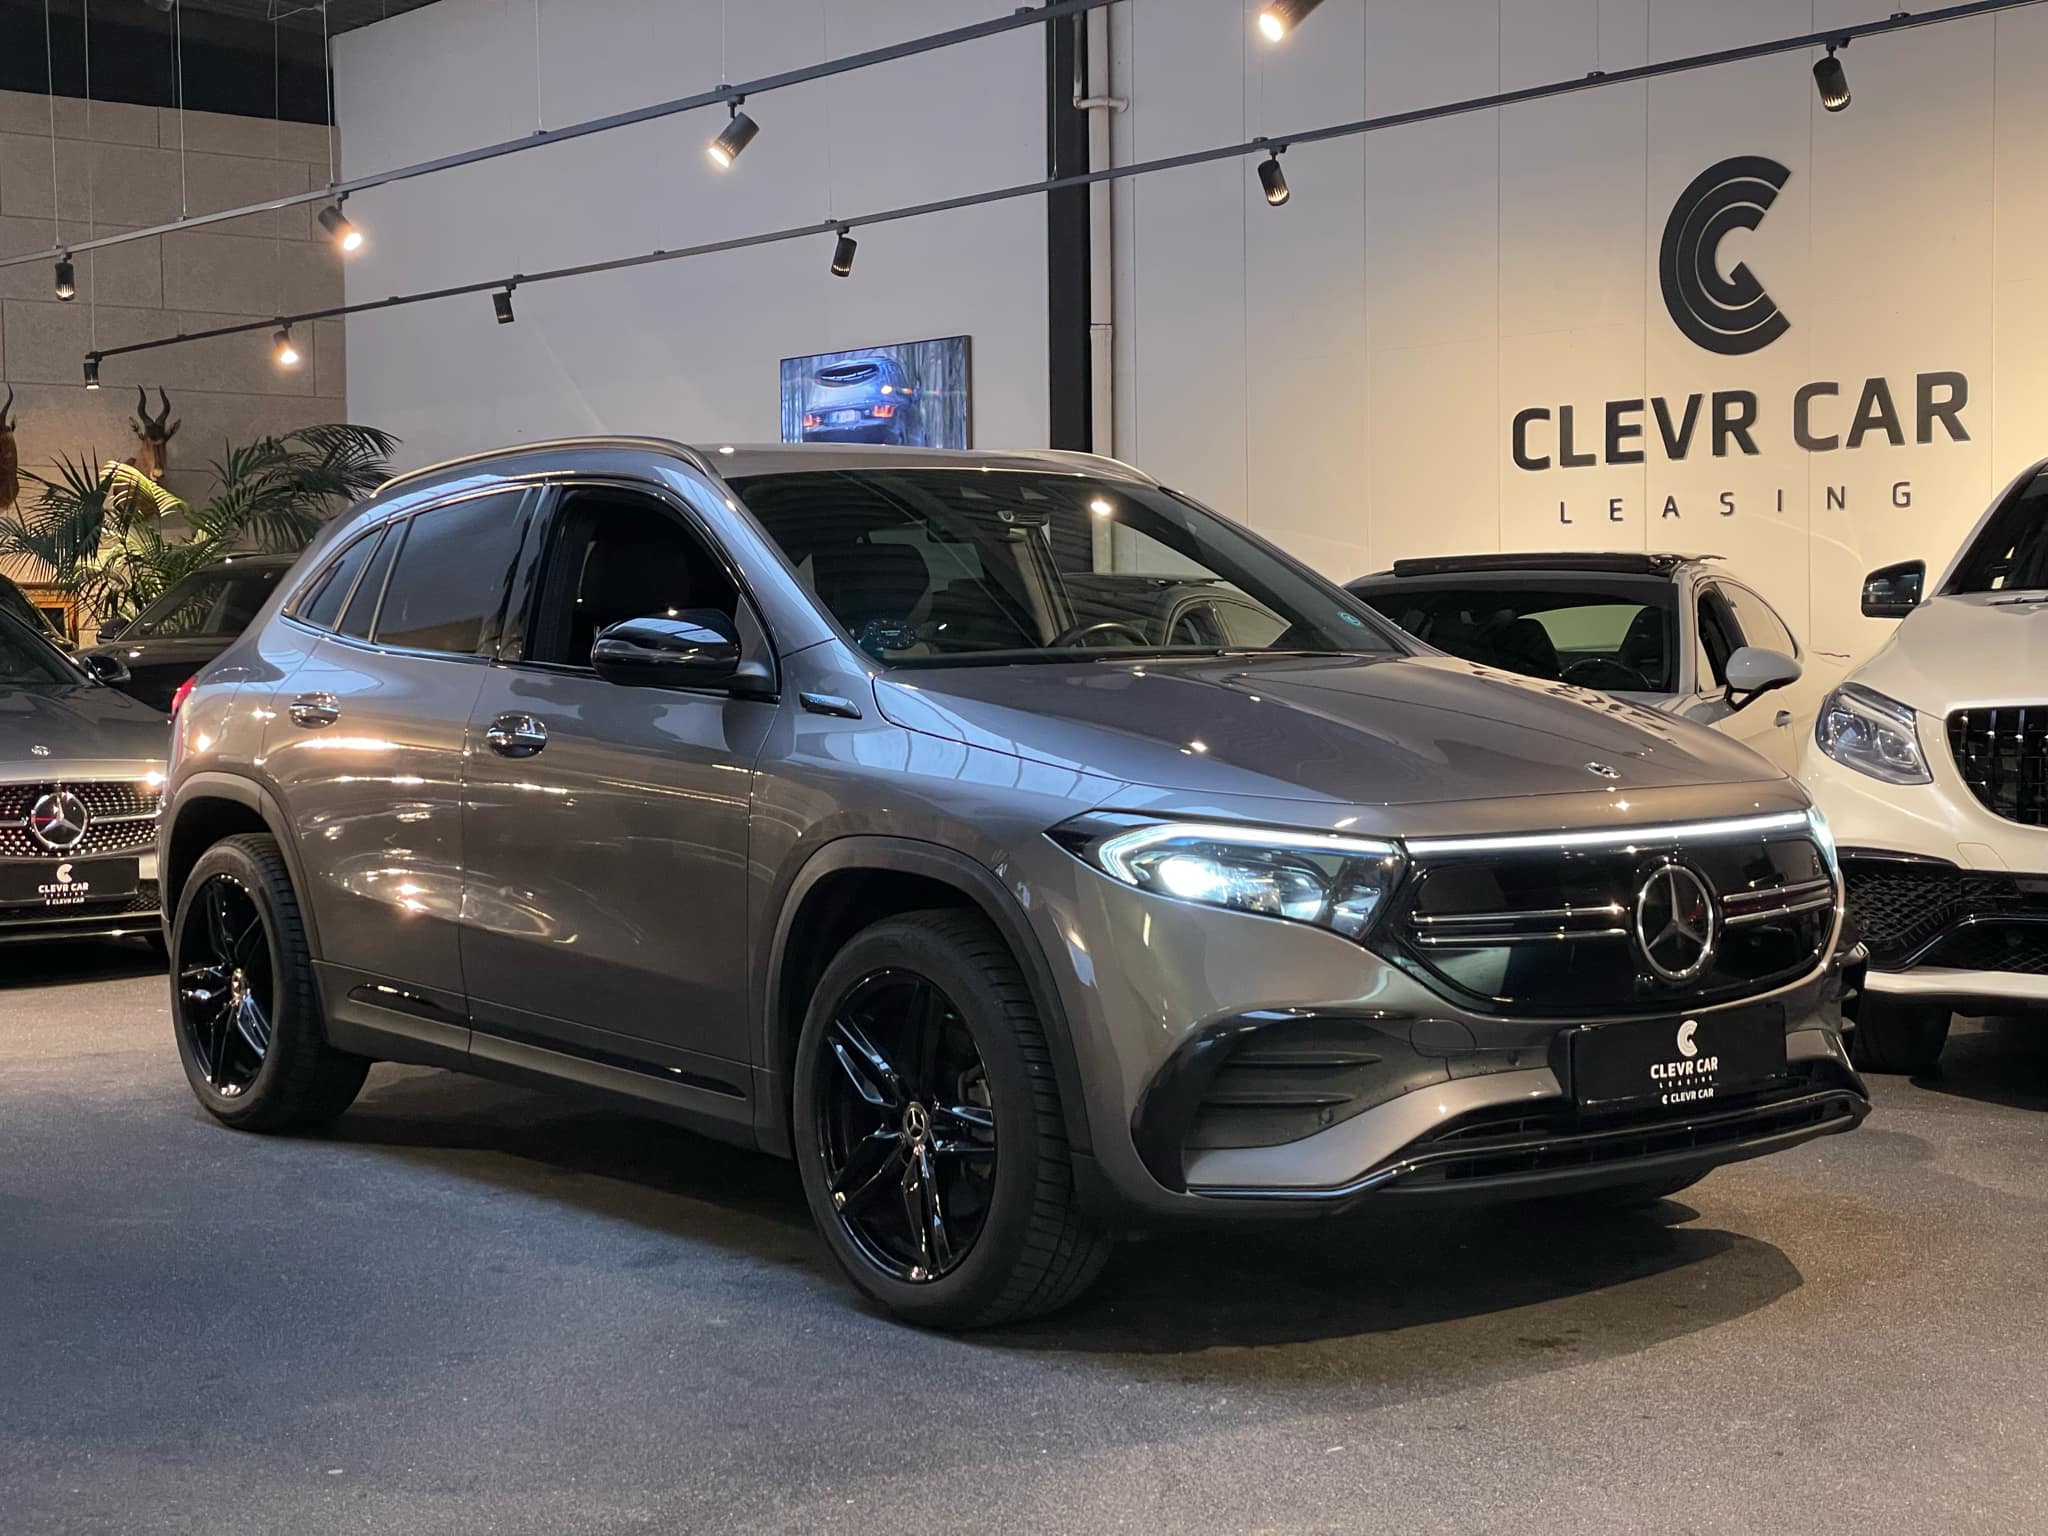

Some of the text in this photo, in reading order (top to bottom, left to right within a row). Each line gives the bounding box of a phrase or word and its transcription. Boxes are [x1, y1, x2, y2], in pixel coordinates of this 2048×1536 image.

[1512, 371, 1971, 472] CLEVR CAR
[1560, 481, 1912, 524] LEASING
[38, 882, 89, 893] CLEVR CAR
[1650, 1056, 1718, 1079] CLEVR CAR
[1670, 1090, 1697, 1103] CLEVR
[1698, 1087, 1714, 1099] CAR
